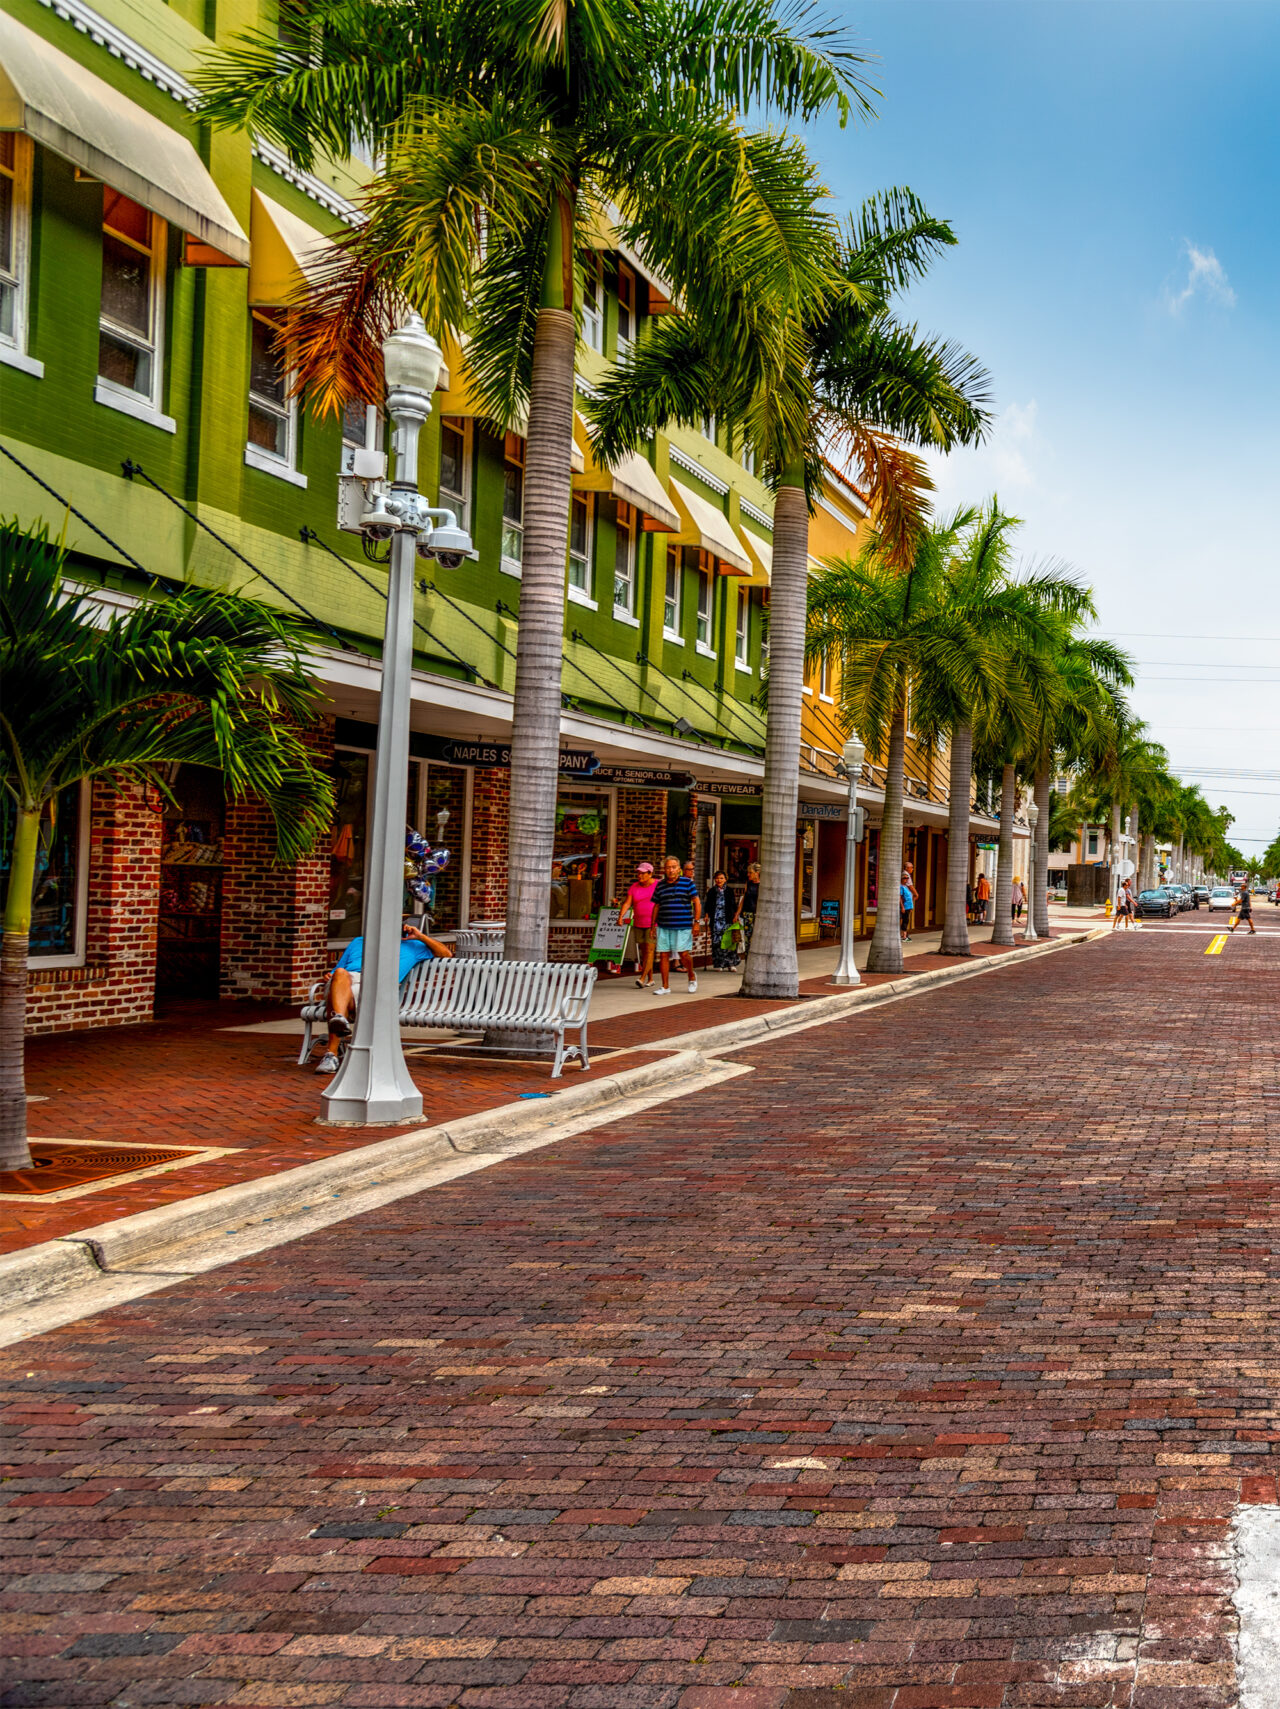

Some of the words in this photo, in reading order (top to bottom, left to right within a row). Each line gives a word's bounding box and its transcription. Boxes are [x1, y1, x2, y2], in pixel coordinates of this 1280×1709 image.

[453, 745, 497, 763] NAPLES
[559, 754, 589, 769] PANY
[613, 776, 646, 784] OPTOMETRY
[711, 783, 756, 795] EYEWEAR
[801, 803, 842, 817] DanaTyler
